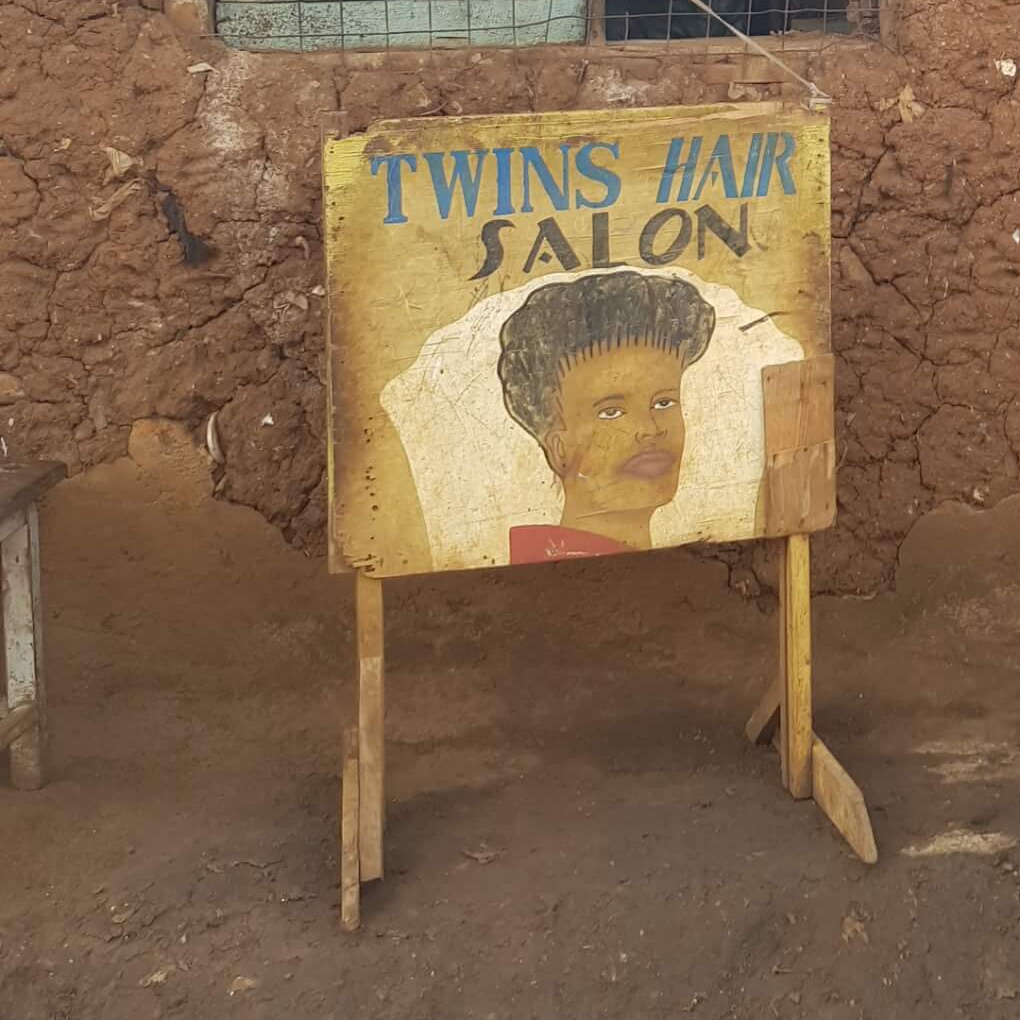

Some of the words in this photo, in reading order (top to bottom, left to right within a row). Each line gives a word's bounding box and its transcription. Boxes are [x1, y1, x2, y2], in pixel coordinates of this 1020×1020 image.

[370, 141, 623, 225] TWINS
[655, 131, 798, 204] HAIR
[467, 203, 752, 281] SALON
